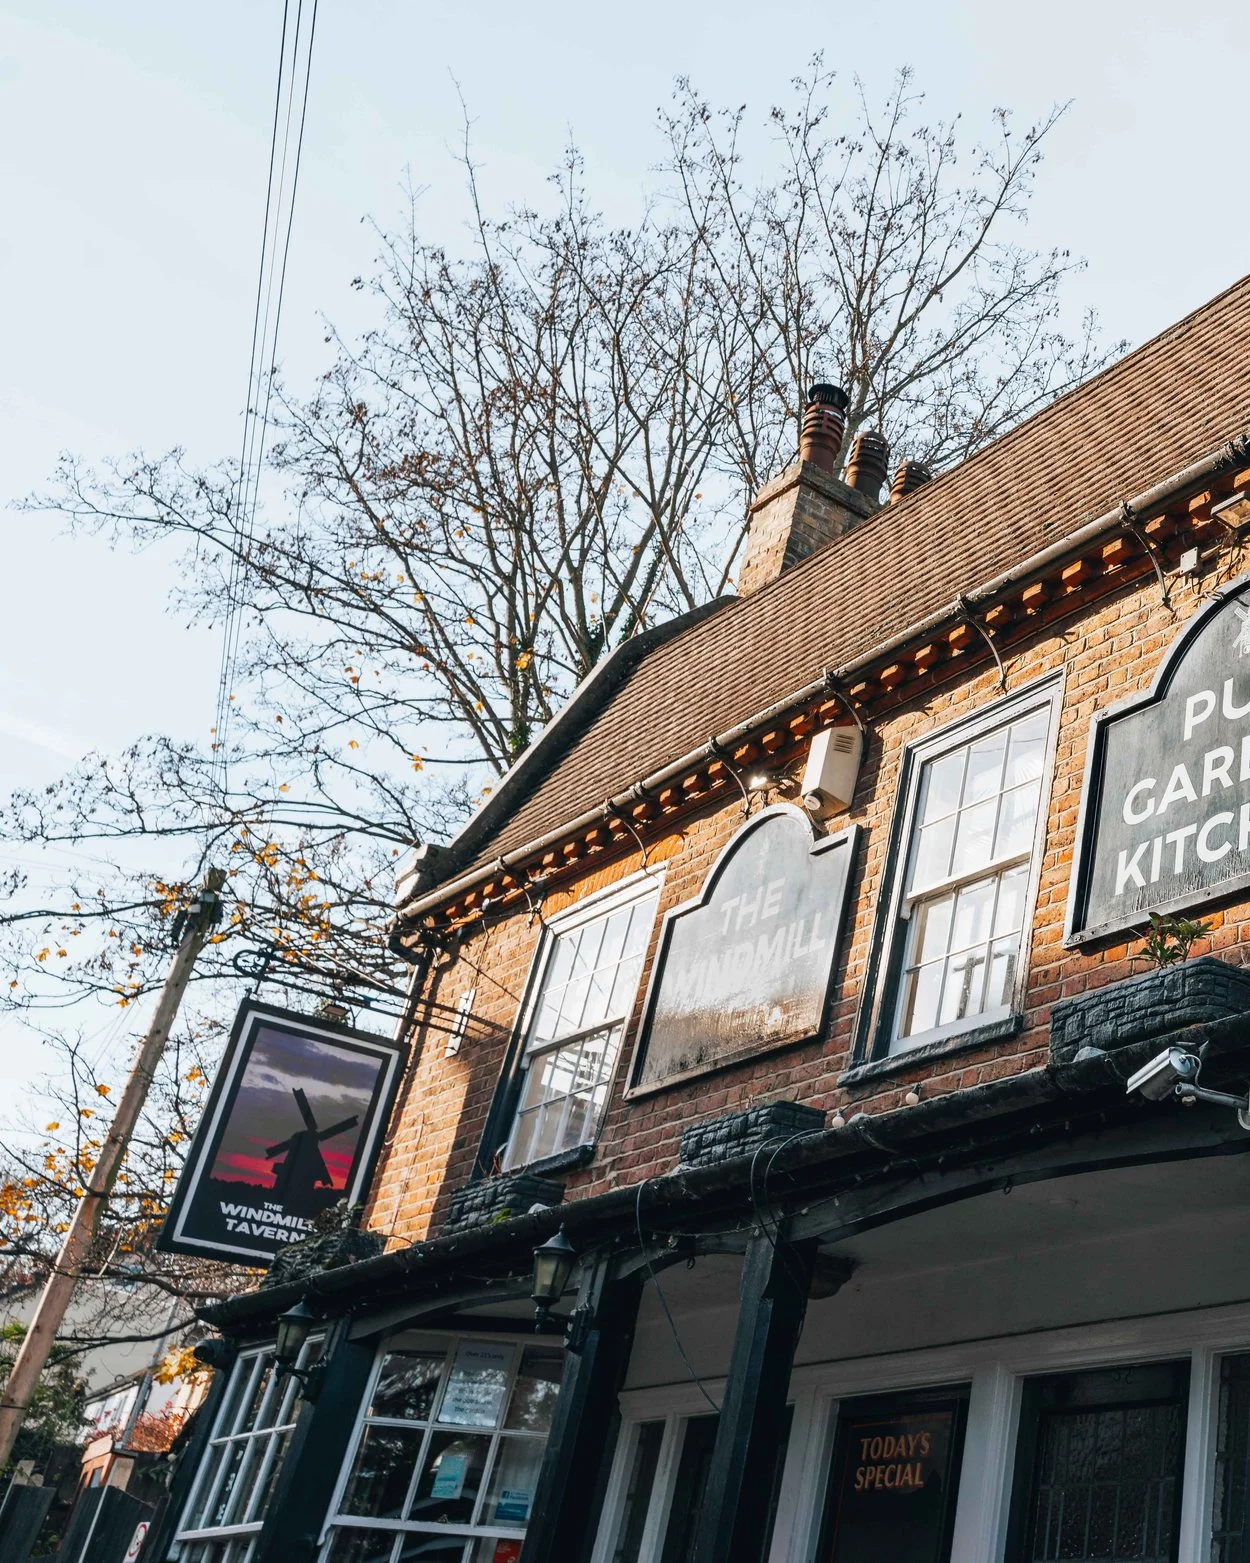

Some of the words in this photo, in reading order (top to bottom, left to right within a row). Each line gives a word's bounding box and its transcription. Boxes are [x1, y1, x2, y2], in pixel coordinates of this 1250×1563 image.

[720, 877, 787, 936] THE
[263, 1201, 283, 1212] THE
[226, 1218, 306, 1243] TAVERN
[860, 1429, 931, 1461] TODAY'S
[854, 1462, 924, 1491] SPECIAL
